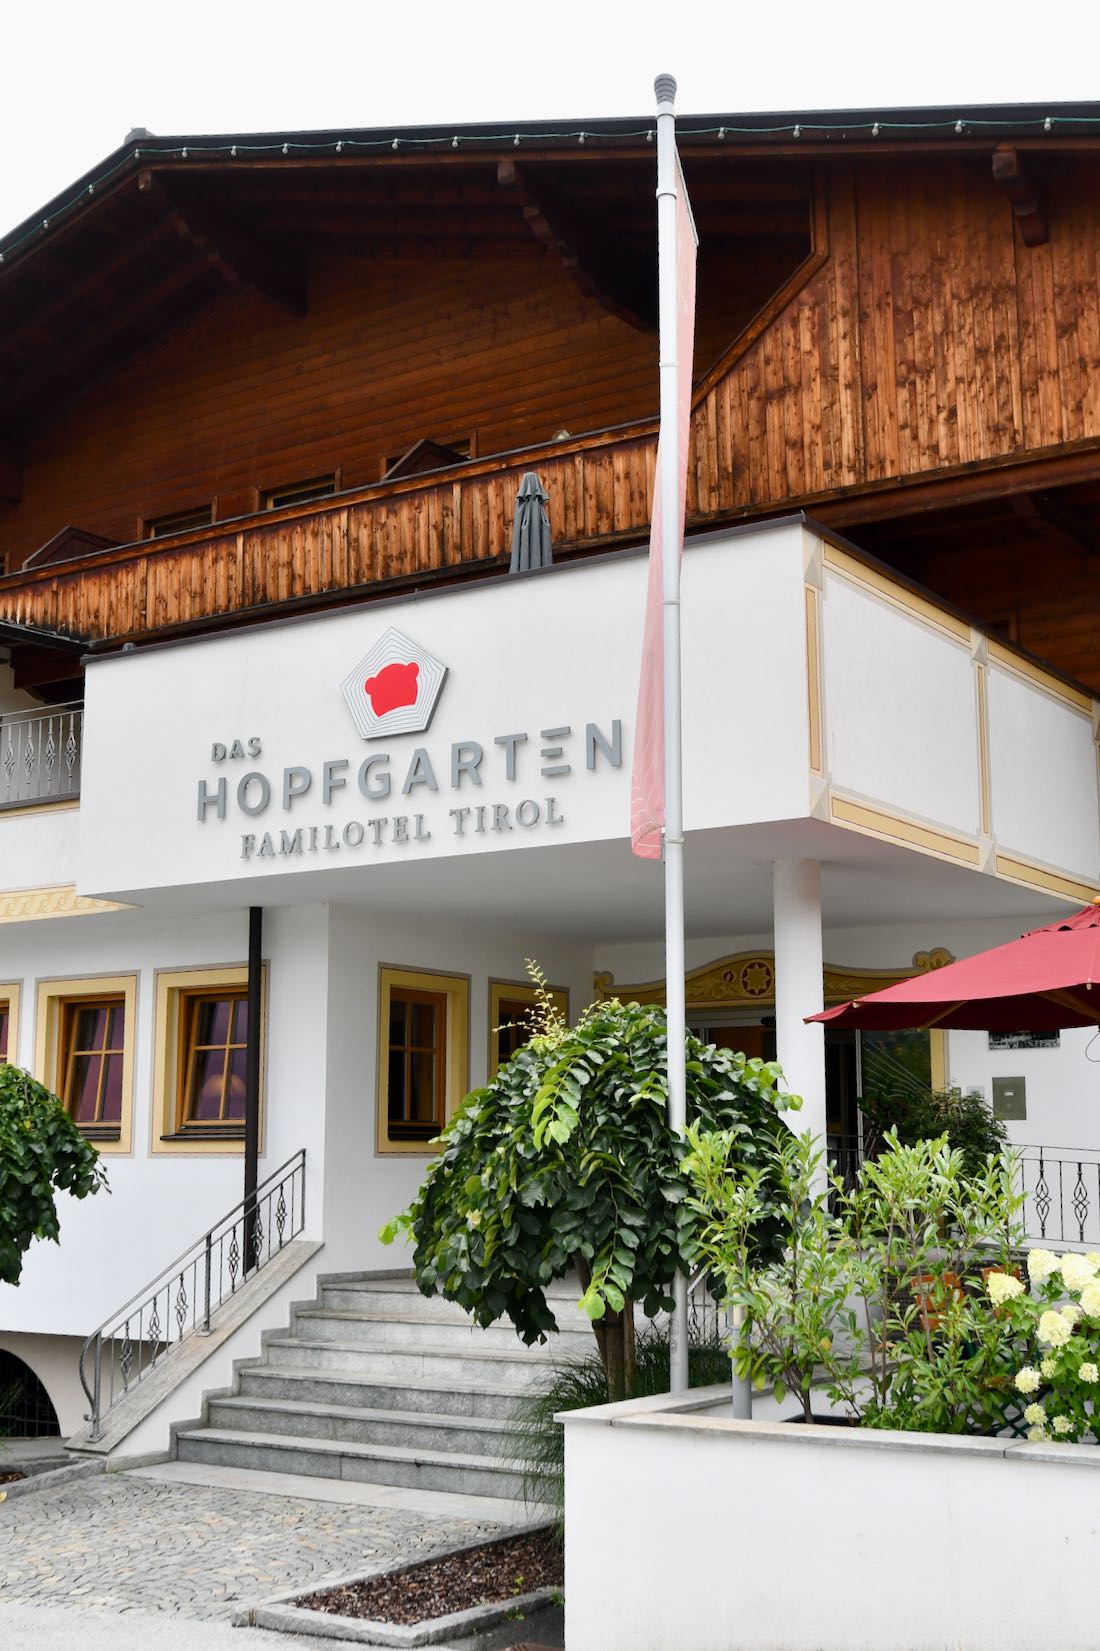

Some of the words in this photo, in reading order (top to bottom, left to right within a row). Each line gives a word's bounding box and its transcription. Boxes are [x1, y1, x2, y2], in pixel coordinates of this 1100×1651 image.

[197, 719, 623, 821] HOPFGARTEN
[211, 736, 262, 763] DAS
[240, 813, 431, 859] FAMILOTEL
[449, 797, 565, 837] TIROL
